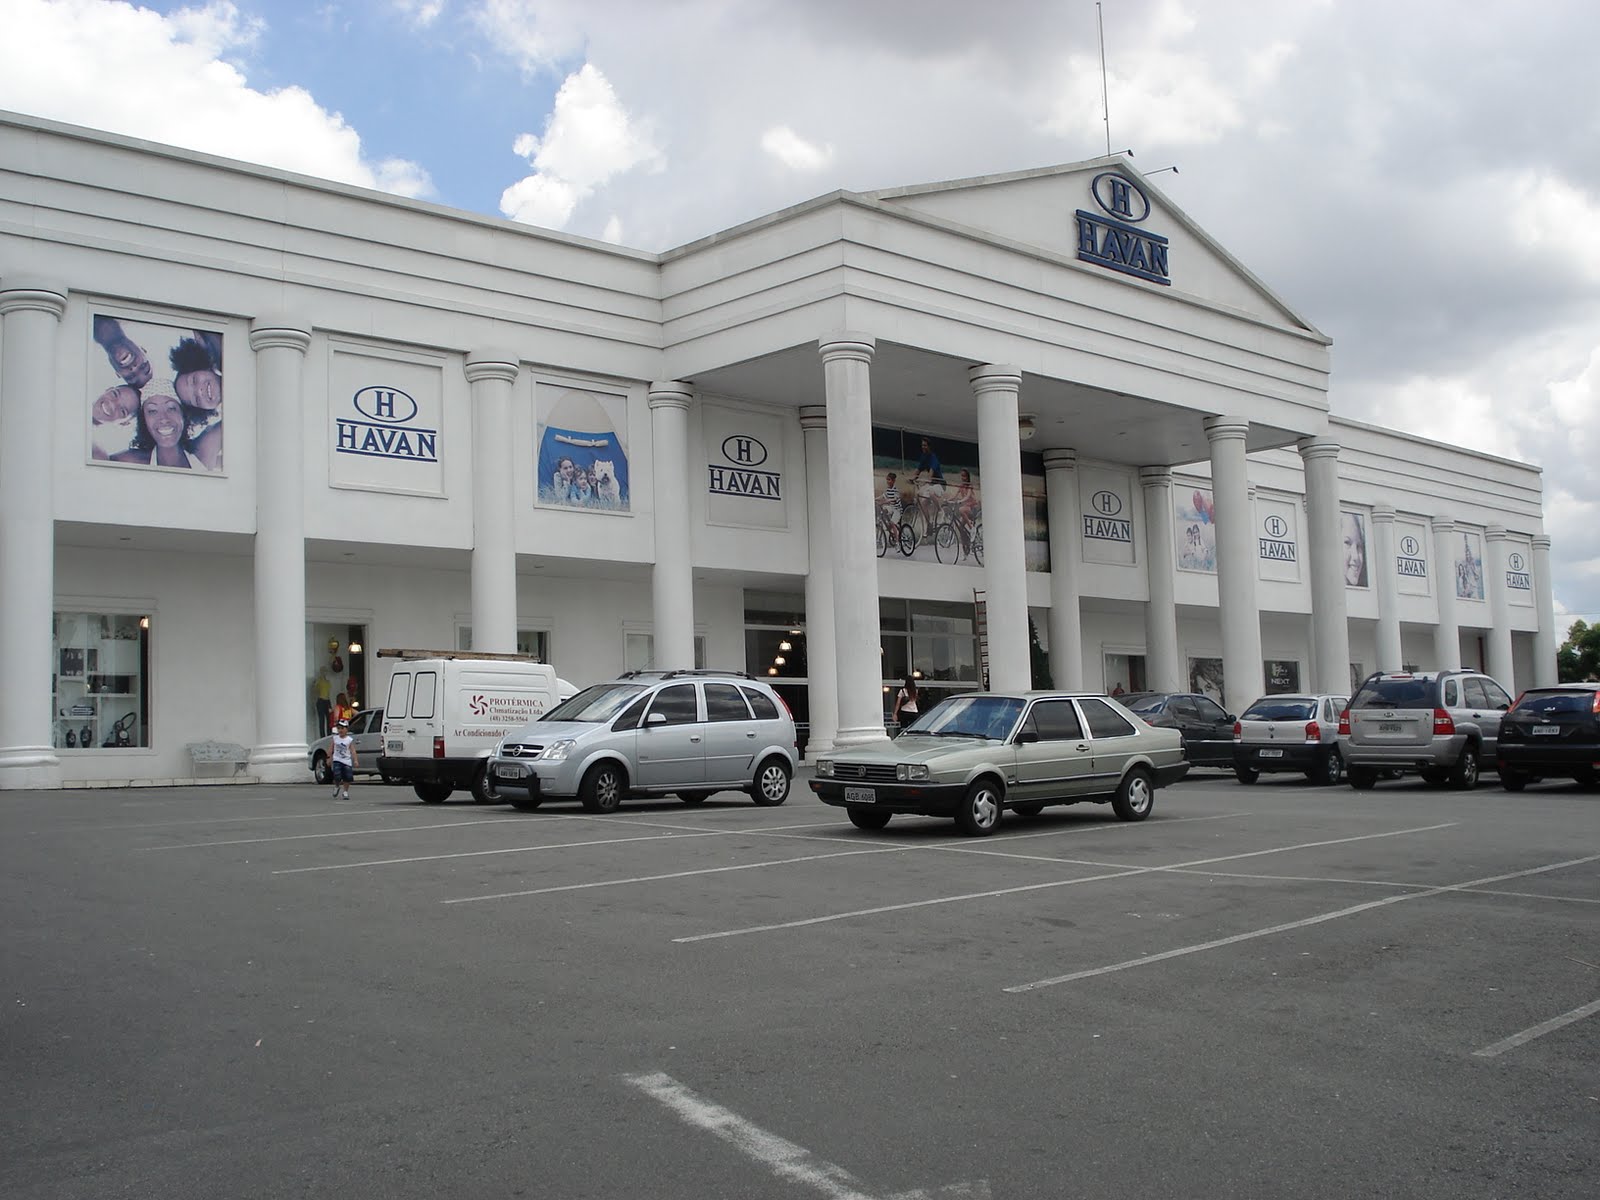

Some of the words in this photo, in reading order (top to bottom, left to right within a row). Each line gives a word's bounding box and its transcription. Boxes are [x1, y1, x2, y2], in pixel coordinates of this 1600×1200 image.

[1110, 179, 1133, 217] H
[1076, 217, 1169, 277] HAVAN
[374, 390, 396, 418] H
[336, 422, 436, 458] HAVAN
[736, 438, 752, 463] H
[708, 468, 781, 497] HAVAN
[1102, 493, 1112, 512] H
[1083, 517, 1130, 539] HAVAN
[1271, 518, 1280, 535] H
[1259, 541, 1295, 559] HAVAN
[1406, 538, 1413, 553] H
[1397, 558, 1425, 575] HAVAN
[1513, 555, 1519, 569] H
[1506, 573, 1530, 588] HAVAN
[489, 697, 544, 708] PROTÉRMICA
[489, 707, 528, 716] Climatização
[453, 729, 462, 737] Ar
[462, 729, 502, 738] Condicionado
